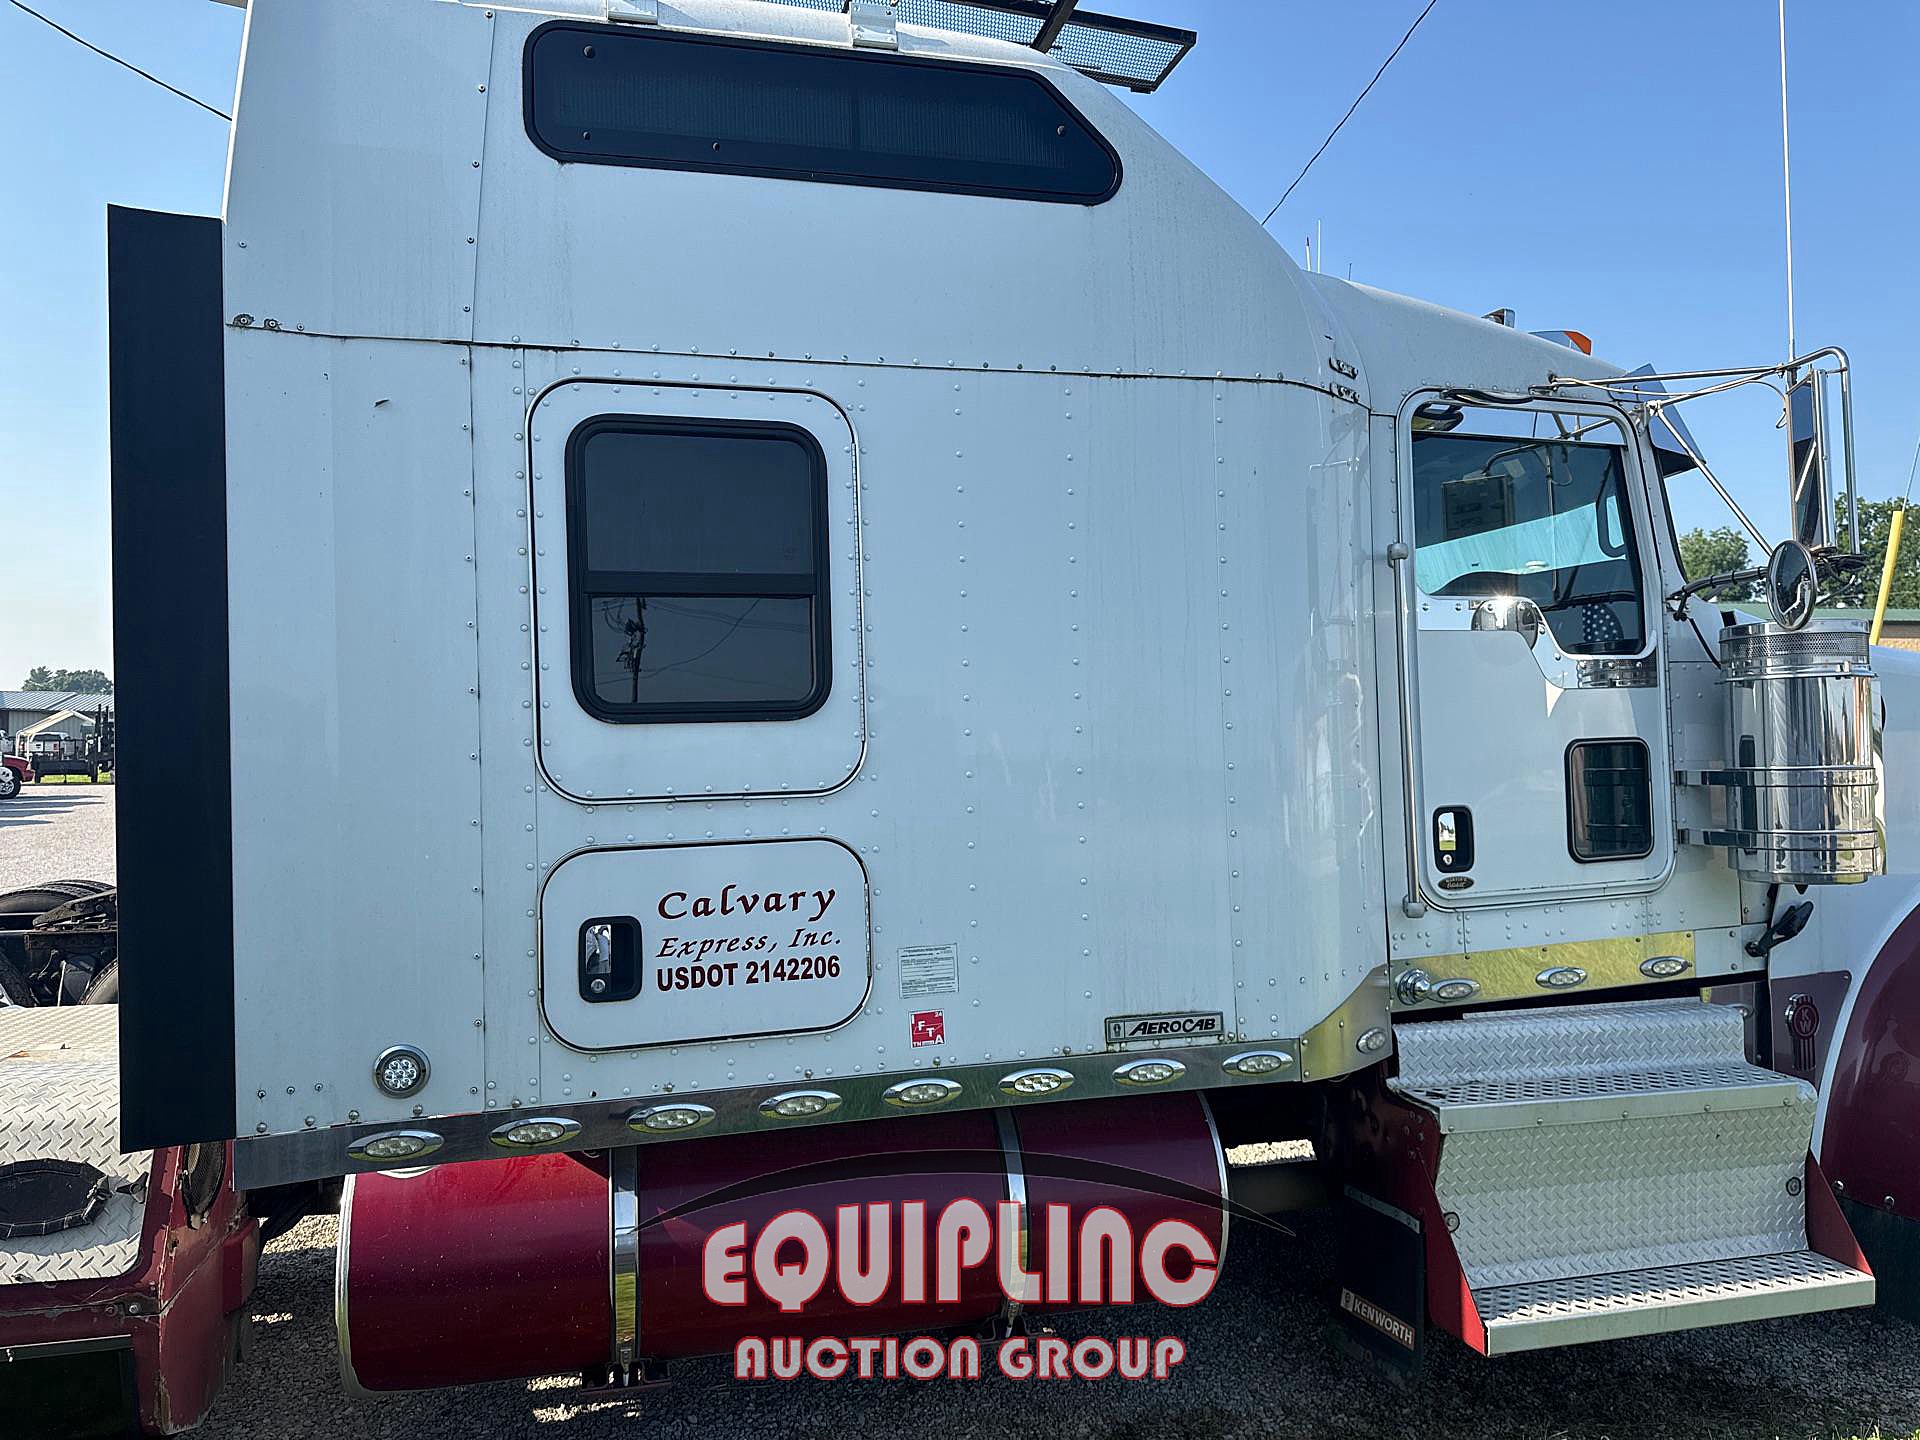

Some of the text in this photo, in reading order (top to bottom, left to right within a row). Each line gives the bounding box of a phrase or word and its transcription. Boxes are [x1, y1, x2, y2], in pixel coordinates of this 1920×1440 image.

[658, 884, 836, 922] Calvary
[656, 928, 841, 962] Express, Inc.
[657, 955, 841, 991] USDOT 2142206
[1129, 1019, 1216, 1036] AEROCAB
[1354, 1299, 1412, 1344] KENWORTH
